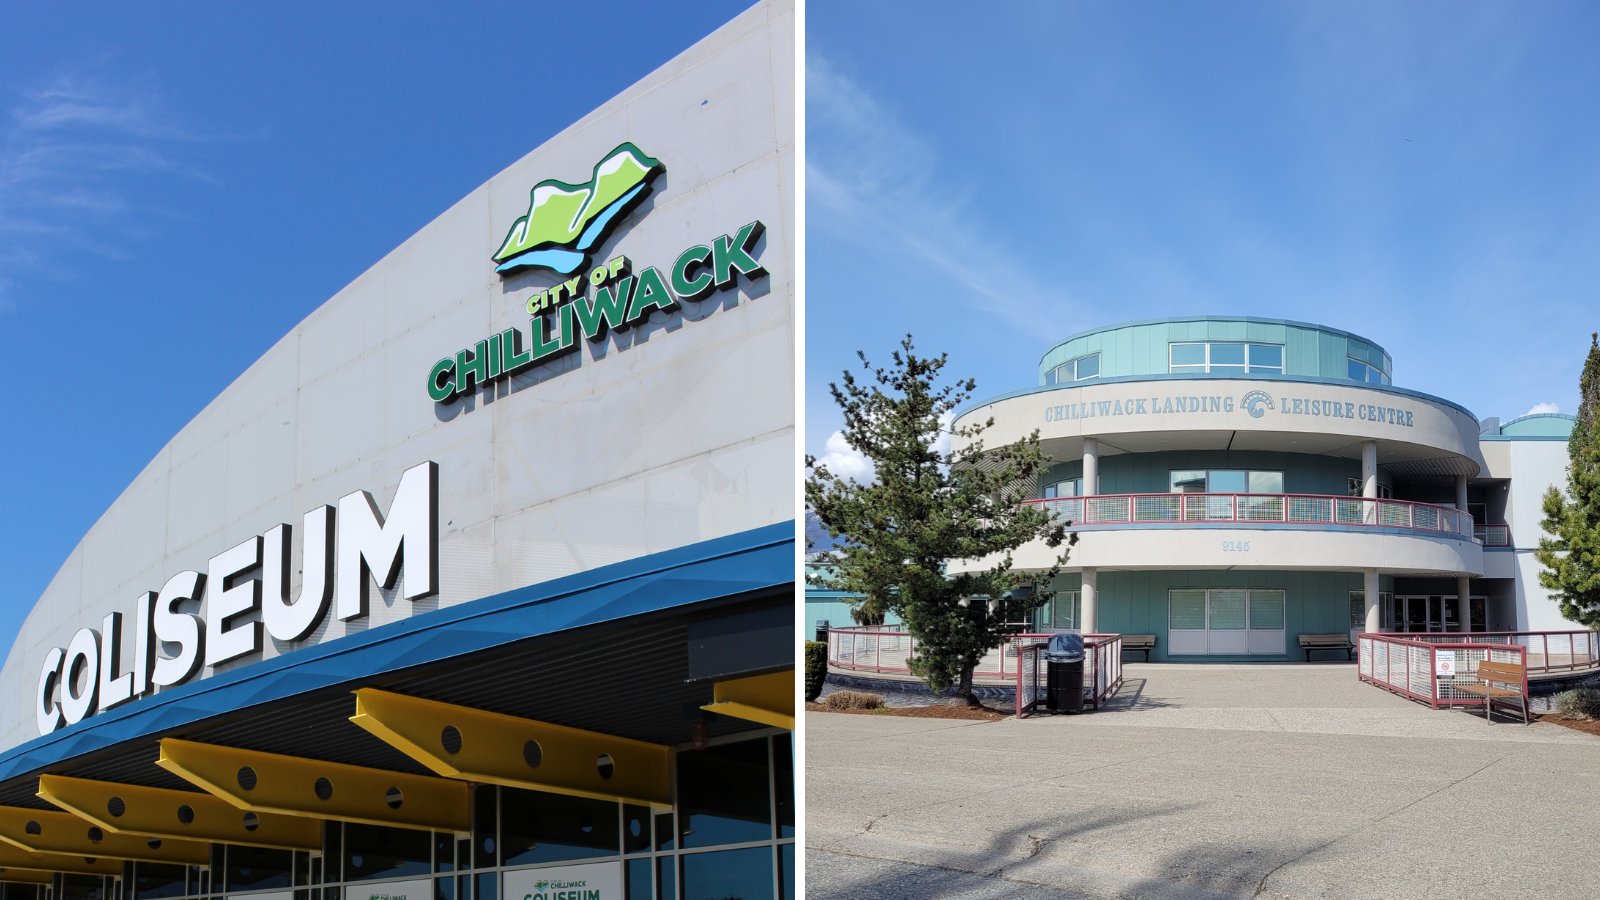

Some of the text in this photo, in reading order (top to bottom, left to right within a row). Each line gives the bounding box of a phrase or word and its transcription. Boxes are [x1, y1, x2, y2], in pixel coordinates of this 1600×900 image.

[525, 255, 627, 315] CITY OF
[426, 220, 766, 404] CHILLIWACK
[1044, 396, 1414, 428] CHILLIWACK LANDING LEISURE CENTRE
[1222, 541, 1250, 552] 9145
[36, 460, 436, 735] COLISEUM
[550, 880, 586, 889] CHILLIWACK
